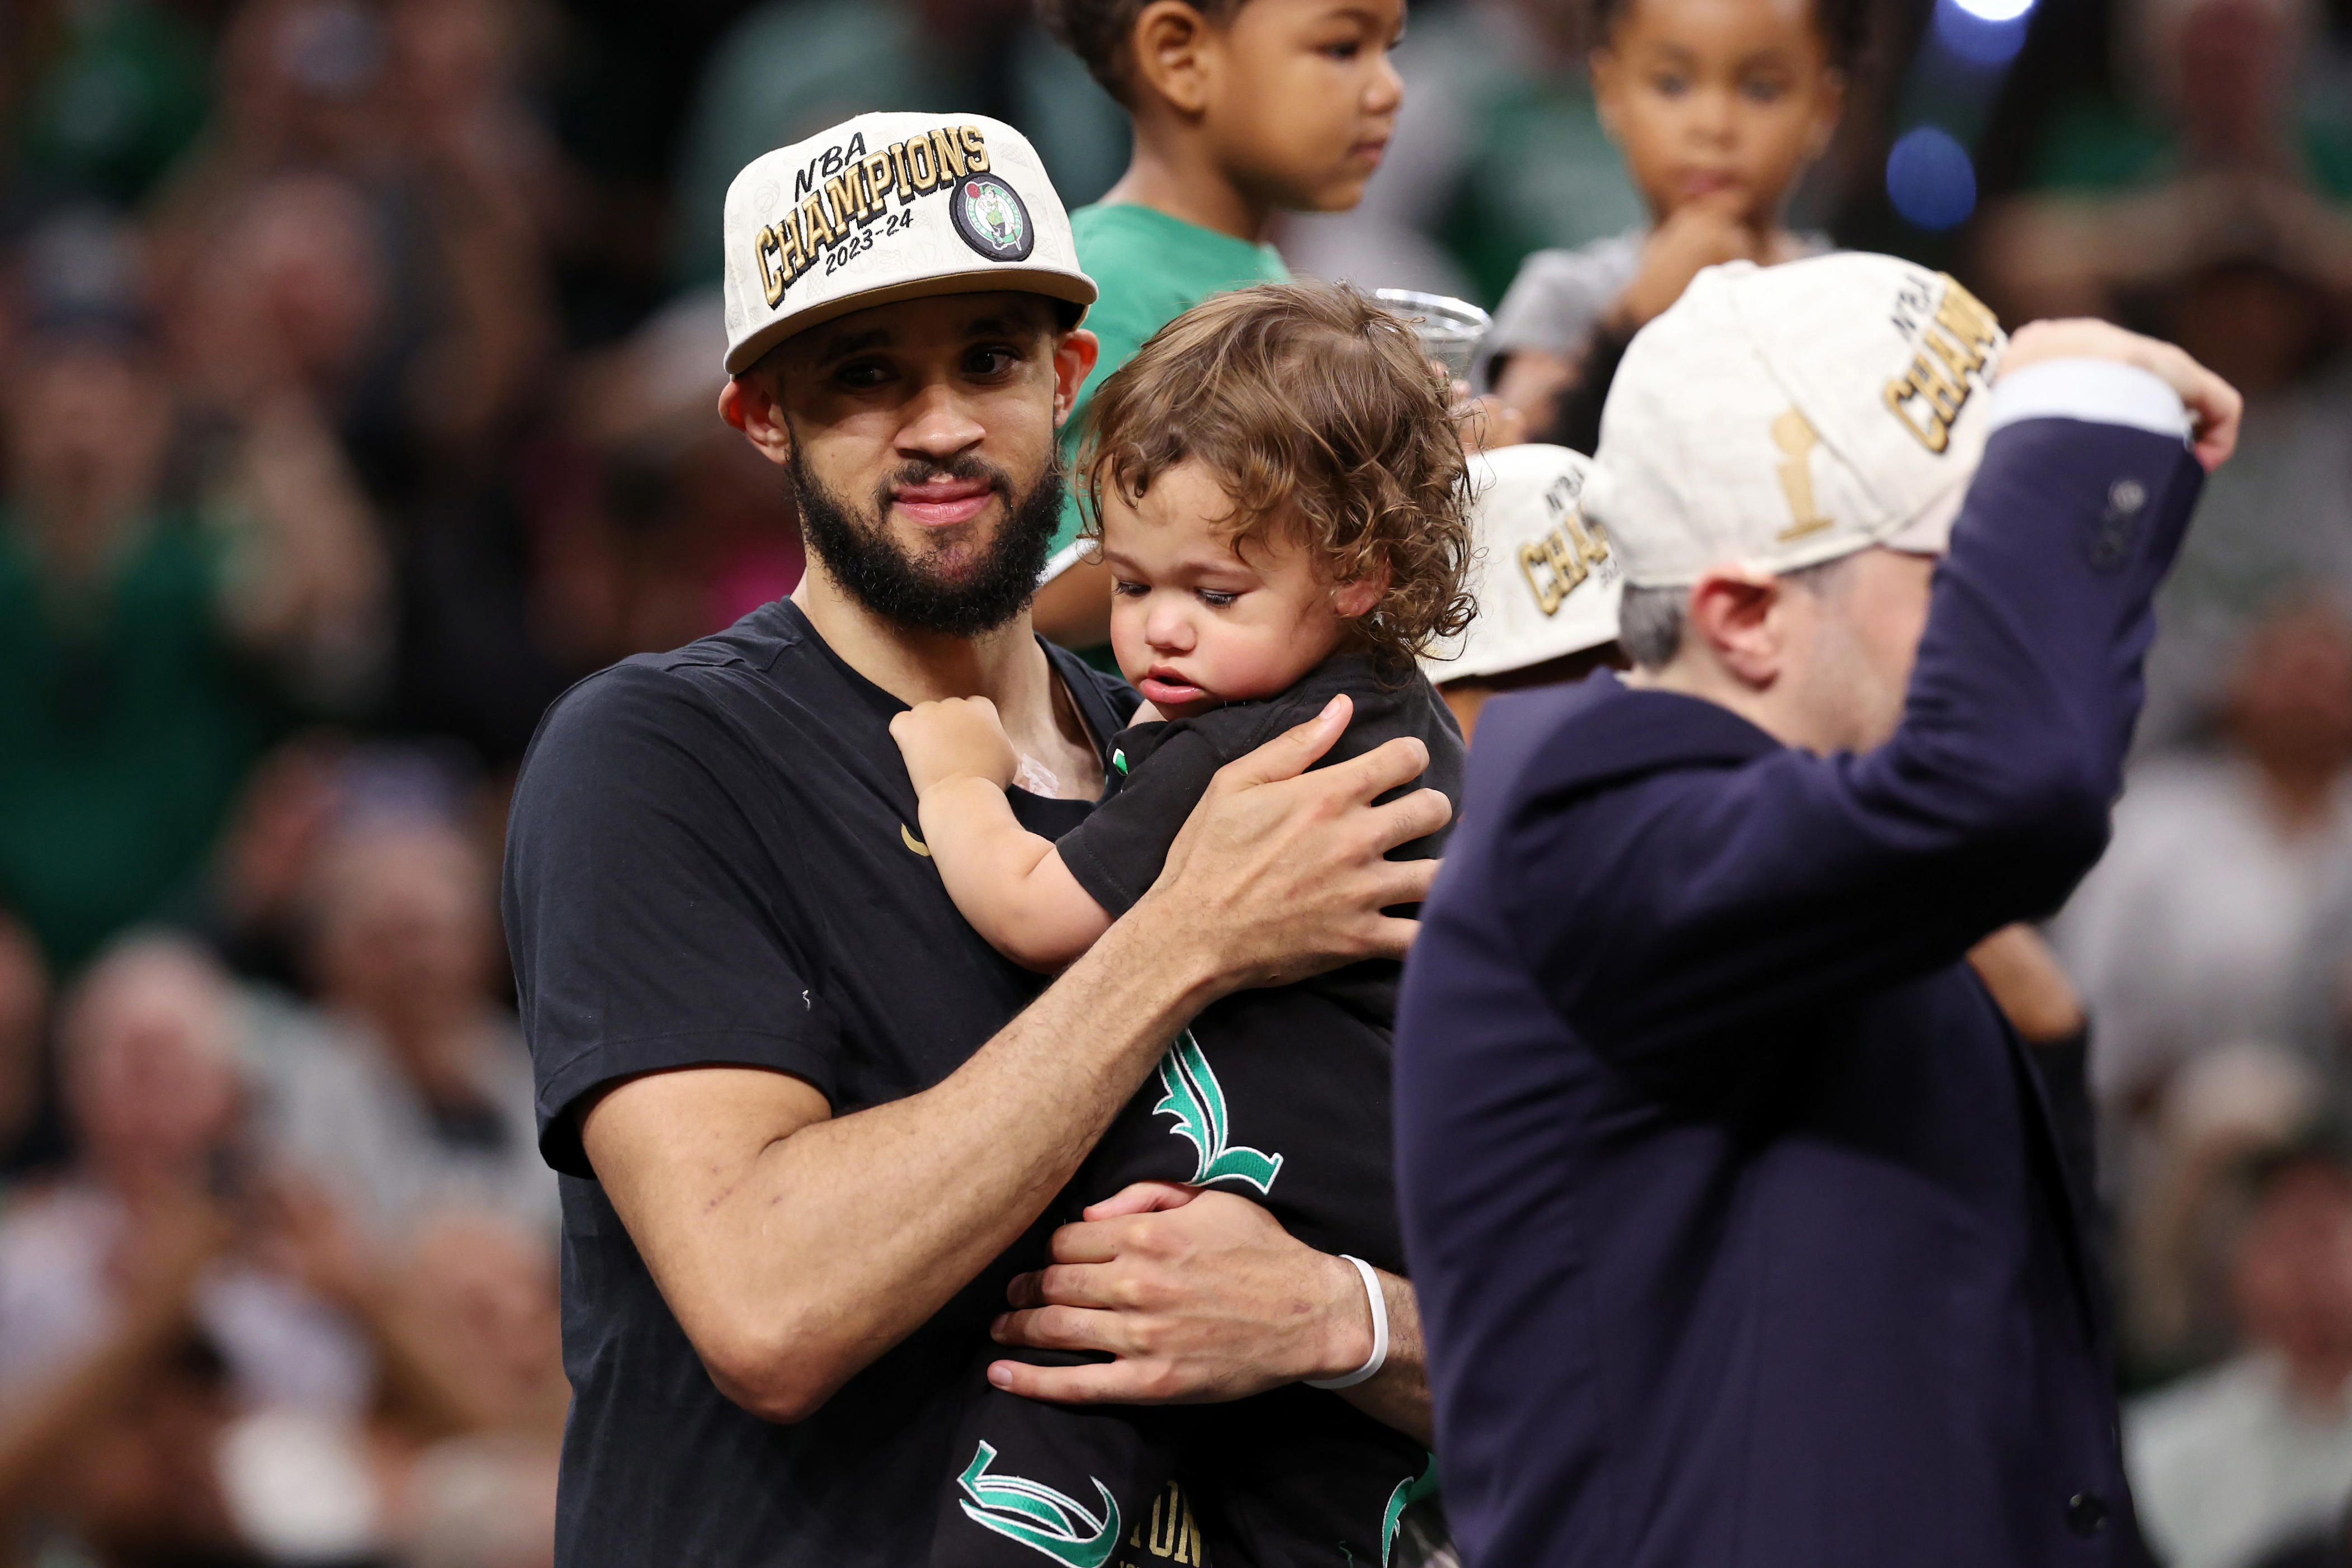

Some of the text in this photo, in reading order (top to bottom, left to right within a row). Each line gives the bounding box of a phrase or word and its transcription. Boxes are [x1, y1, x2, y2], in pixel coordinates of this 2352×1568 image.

[794, 131, 867, 203] NBA
[755, 125, 990, 310] CHAMPIONS
[825, 207, 914, 277] 2023-24
[968, 197, 988, 235] BOSTON
[1518, 510, 1609, 616] CHA
